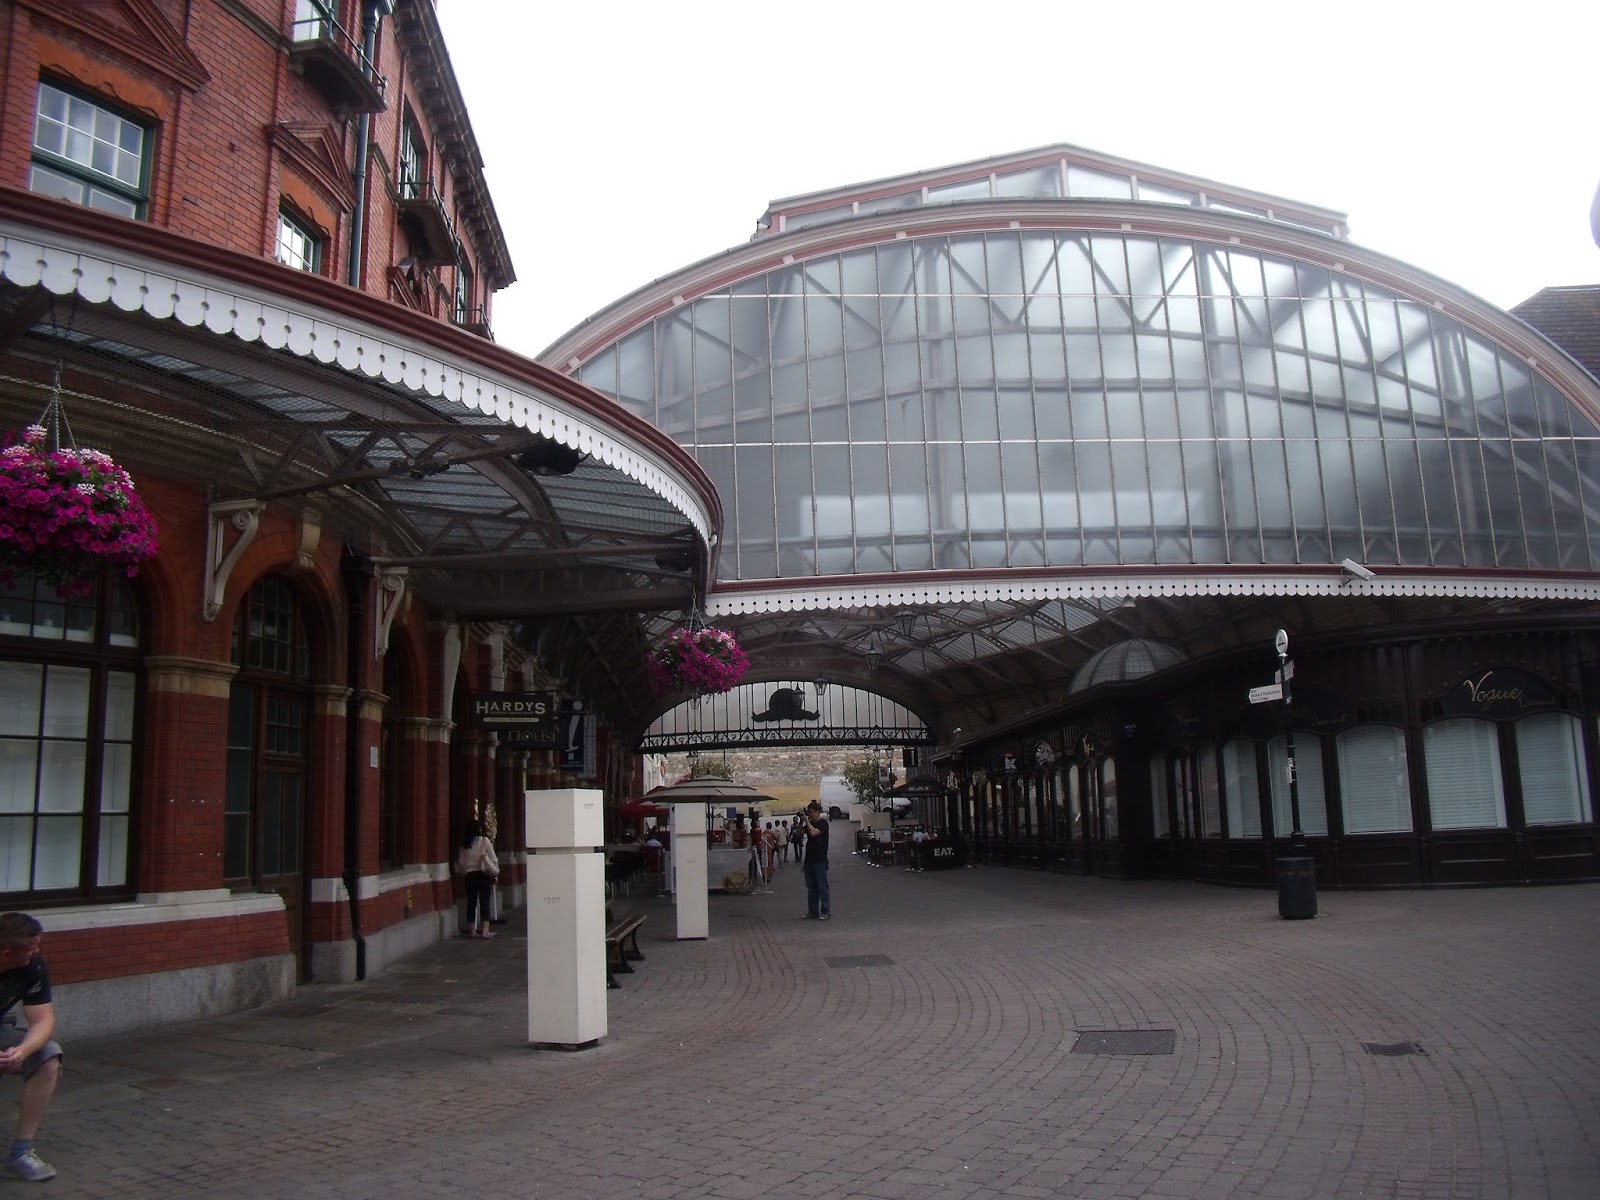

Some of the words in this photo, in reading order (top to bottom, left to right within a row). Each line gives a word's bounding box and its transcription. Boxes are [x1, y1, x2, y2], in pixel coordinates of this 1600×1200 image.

[1463, 671, 1522, 711] Vogue
[476, 701, 546, 715] HARDYS
[934, 848, 954, 856] EAT.
